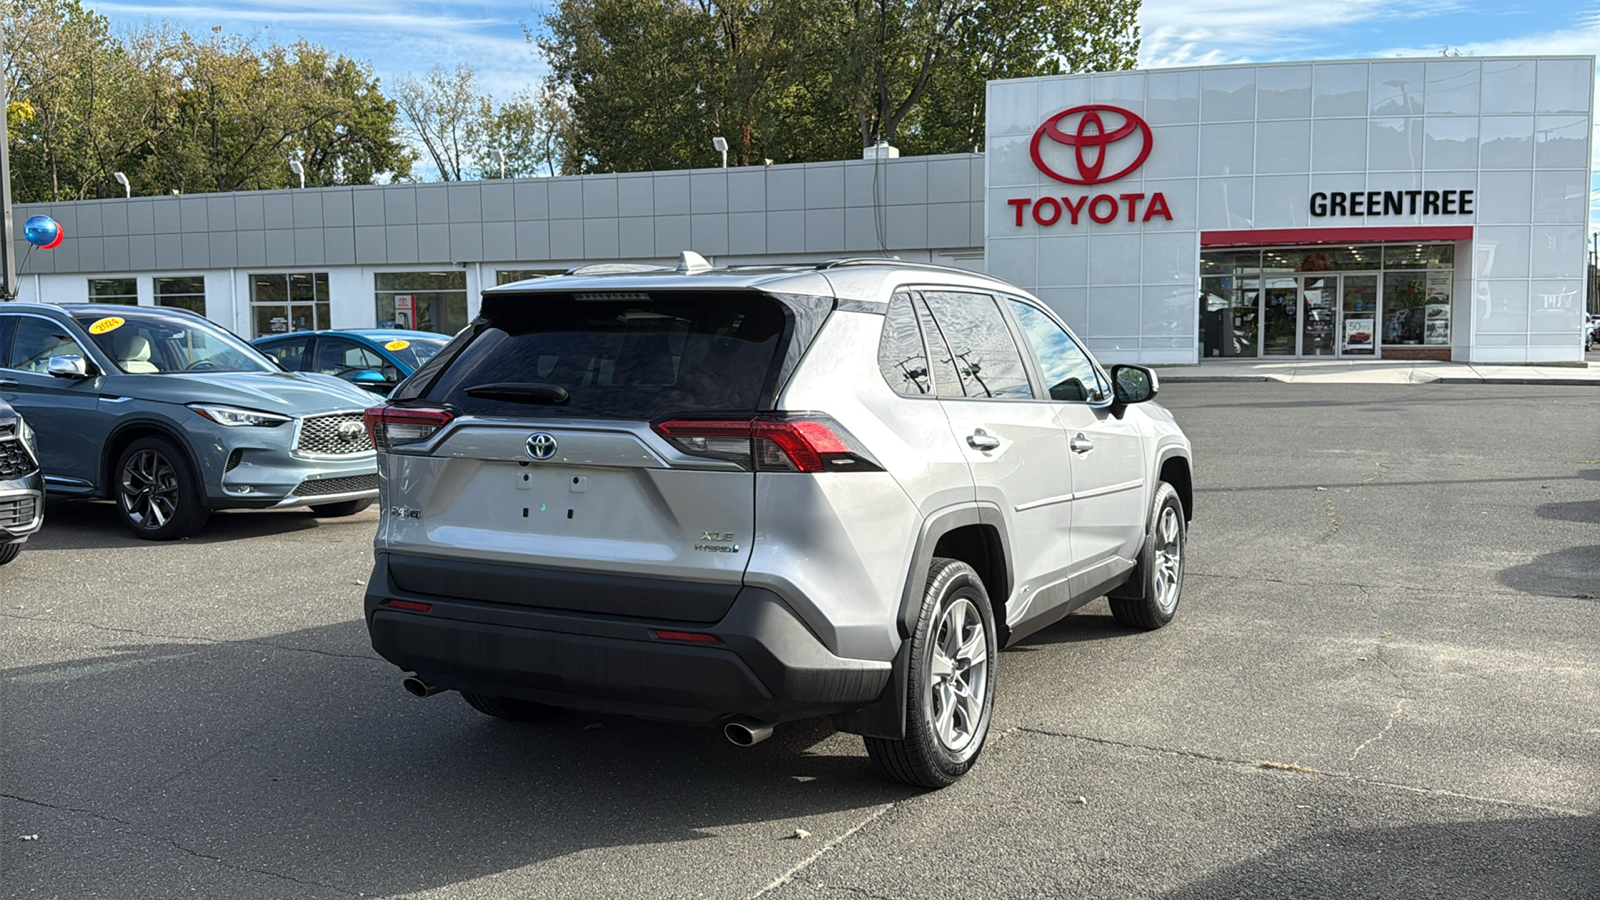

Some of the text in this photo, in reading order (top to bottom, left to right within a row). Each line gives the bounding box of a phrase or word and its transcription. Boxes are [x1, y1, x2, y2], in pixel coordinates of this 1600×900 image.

[1007, 192, 1173, 227] TOYOTA
[1309, 190, 1474, 217] GREENTREE
[95, 318, 119, 331] 2024
[700, 531, 735, 541] XLE
[694, 544, 732, 552] HYBRID
